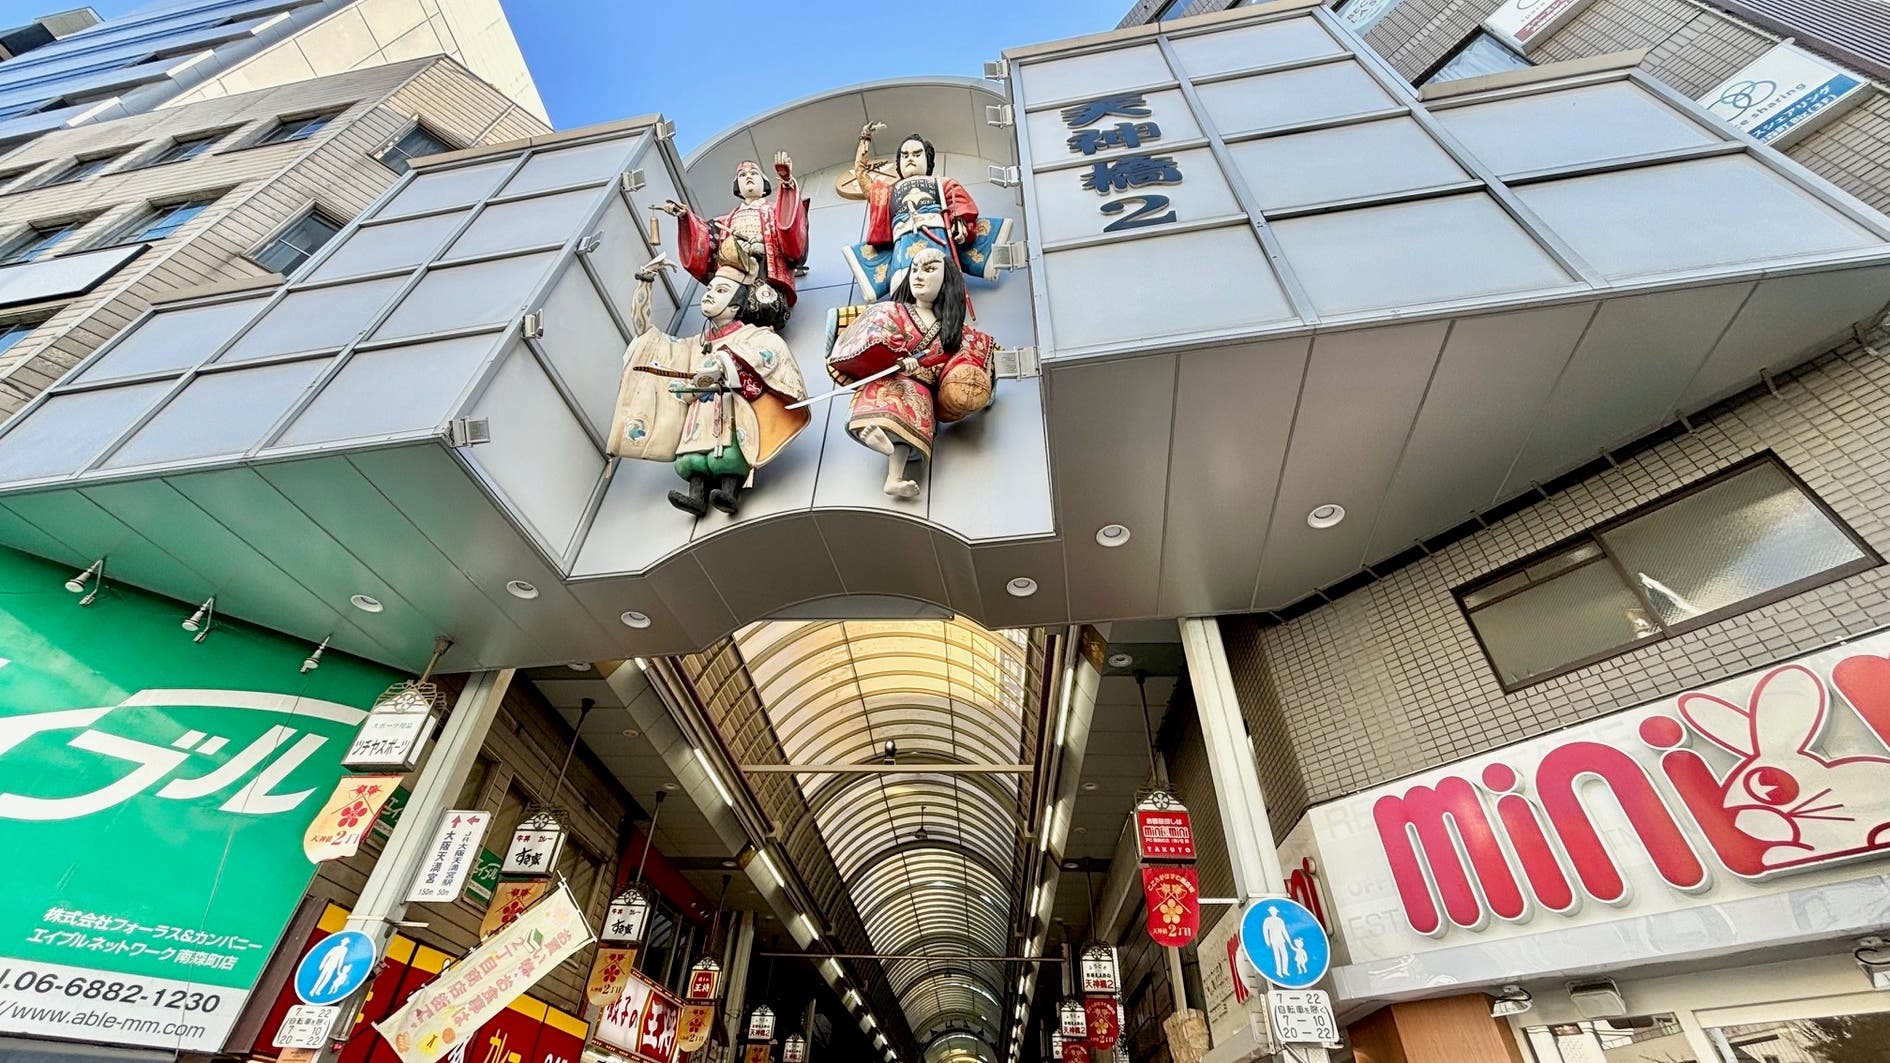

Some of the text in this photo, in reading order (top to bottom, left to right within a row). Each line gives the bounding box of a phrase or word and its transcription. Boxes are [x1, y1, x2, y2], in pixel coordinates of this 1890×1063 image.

[1751, 82, 1807, 119] sharing
[1060, 93, 1184, 233] 天神橋2
[351, 739, 411, 756] ツチヤスポーツ
[1143, 826, 1190, 839] mini mini
[1372, 713, 1770, 938] mini
[425, 831, 456, 884] 大阪天満宮
[515, 847, 543, 868] すき家
[42, 906, 263, 950] 株式会社フォーラス&カンパニー
[611, 919, 634, 936] すき家
[26, 928, 239, 971] エイブルネットワーク 南森町店
[693, 983, 710, 993] 王将
[1085, 979, 1114, 989] 天神橋2
